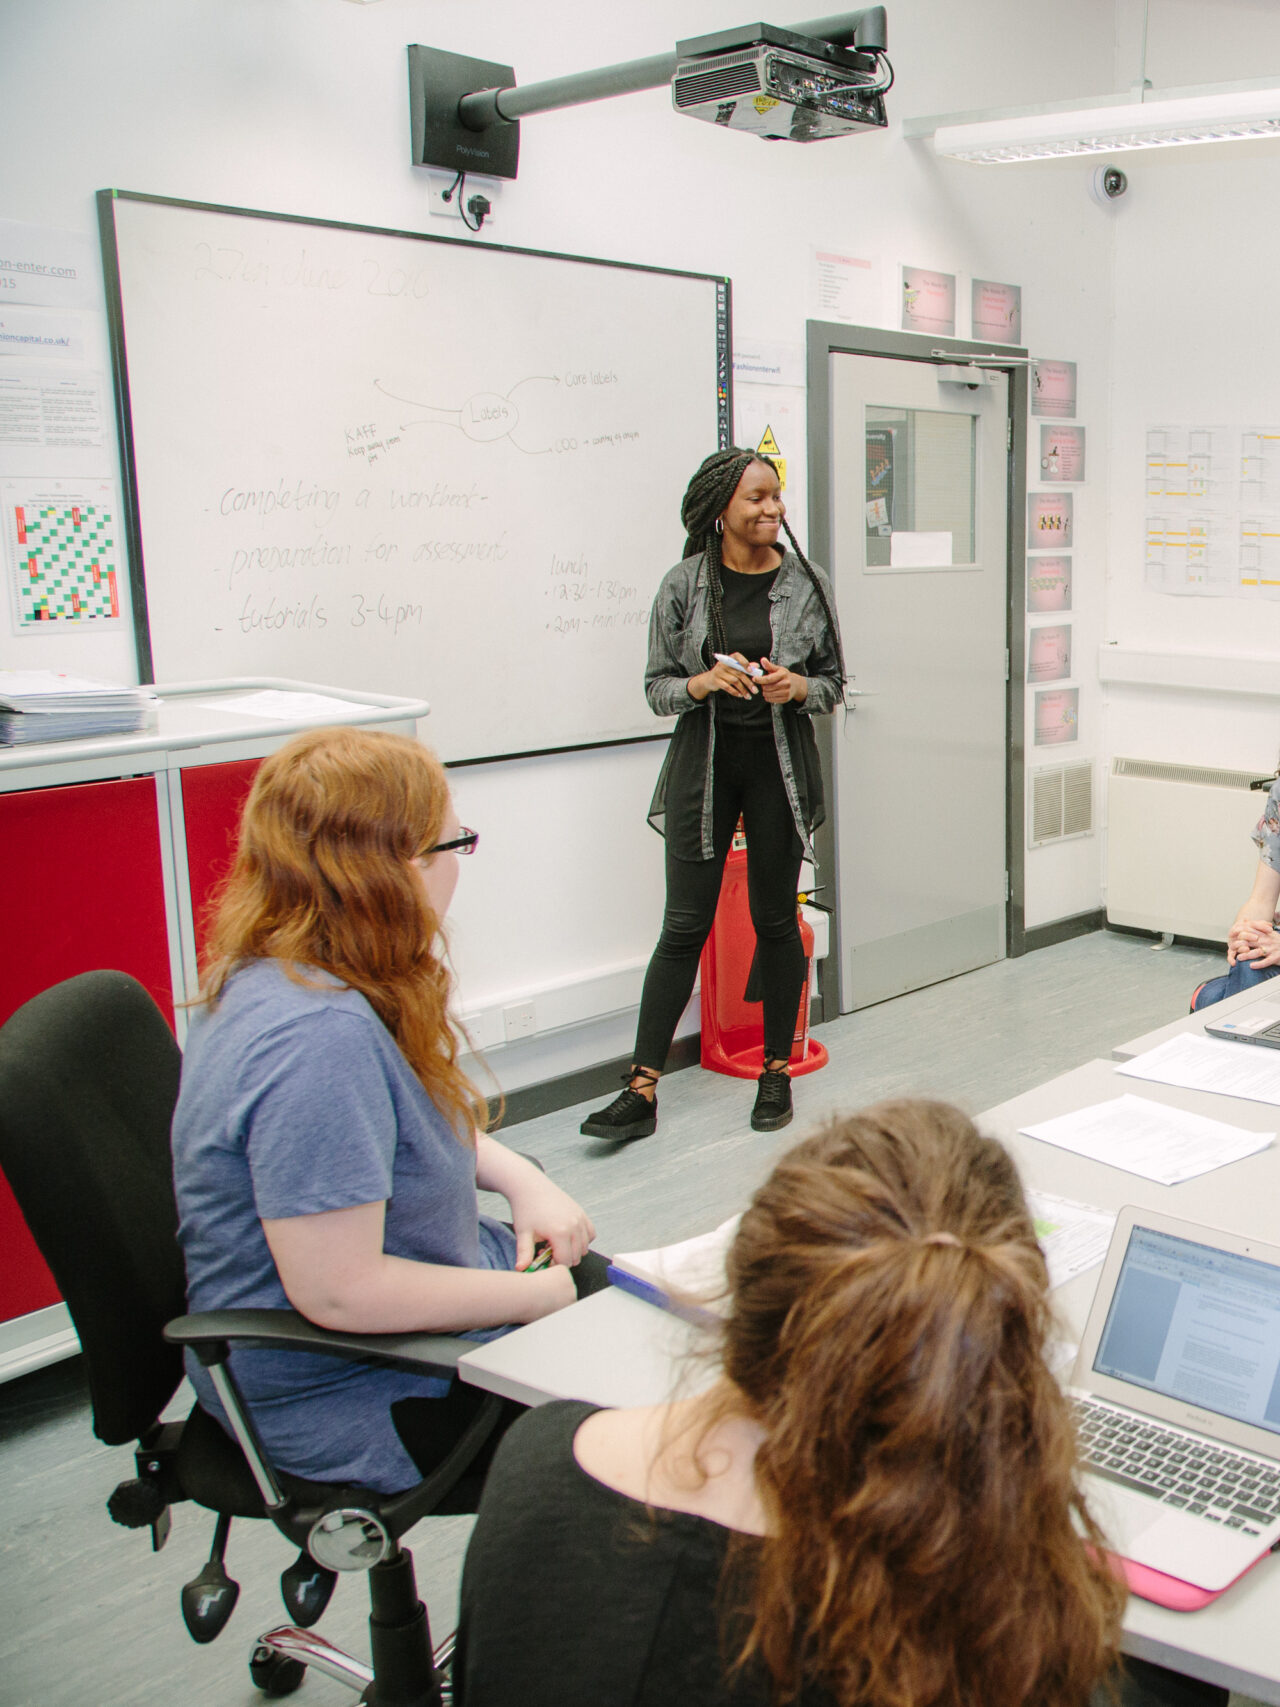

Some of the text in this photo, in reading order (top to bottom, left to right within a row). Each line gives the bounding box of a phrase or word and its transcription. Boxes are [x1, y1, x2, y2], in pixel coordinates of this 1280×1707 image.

[456, 144, 490, 159] PolyVision
[470, 401, 509, 423] Labels
[344, 423, 377, 444] KAFF
[238, 593, 328, 634] tutorials
